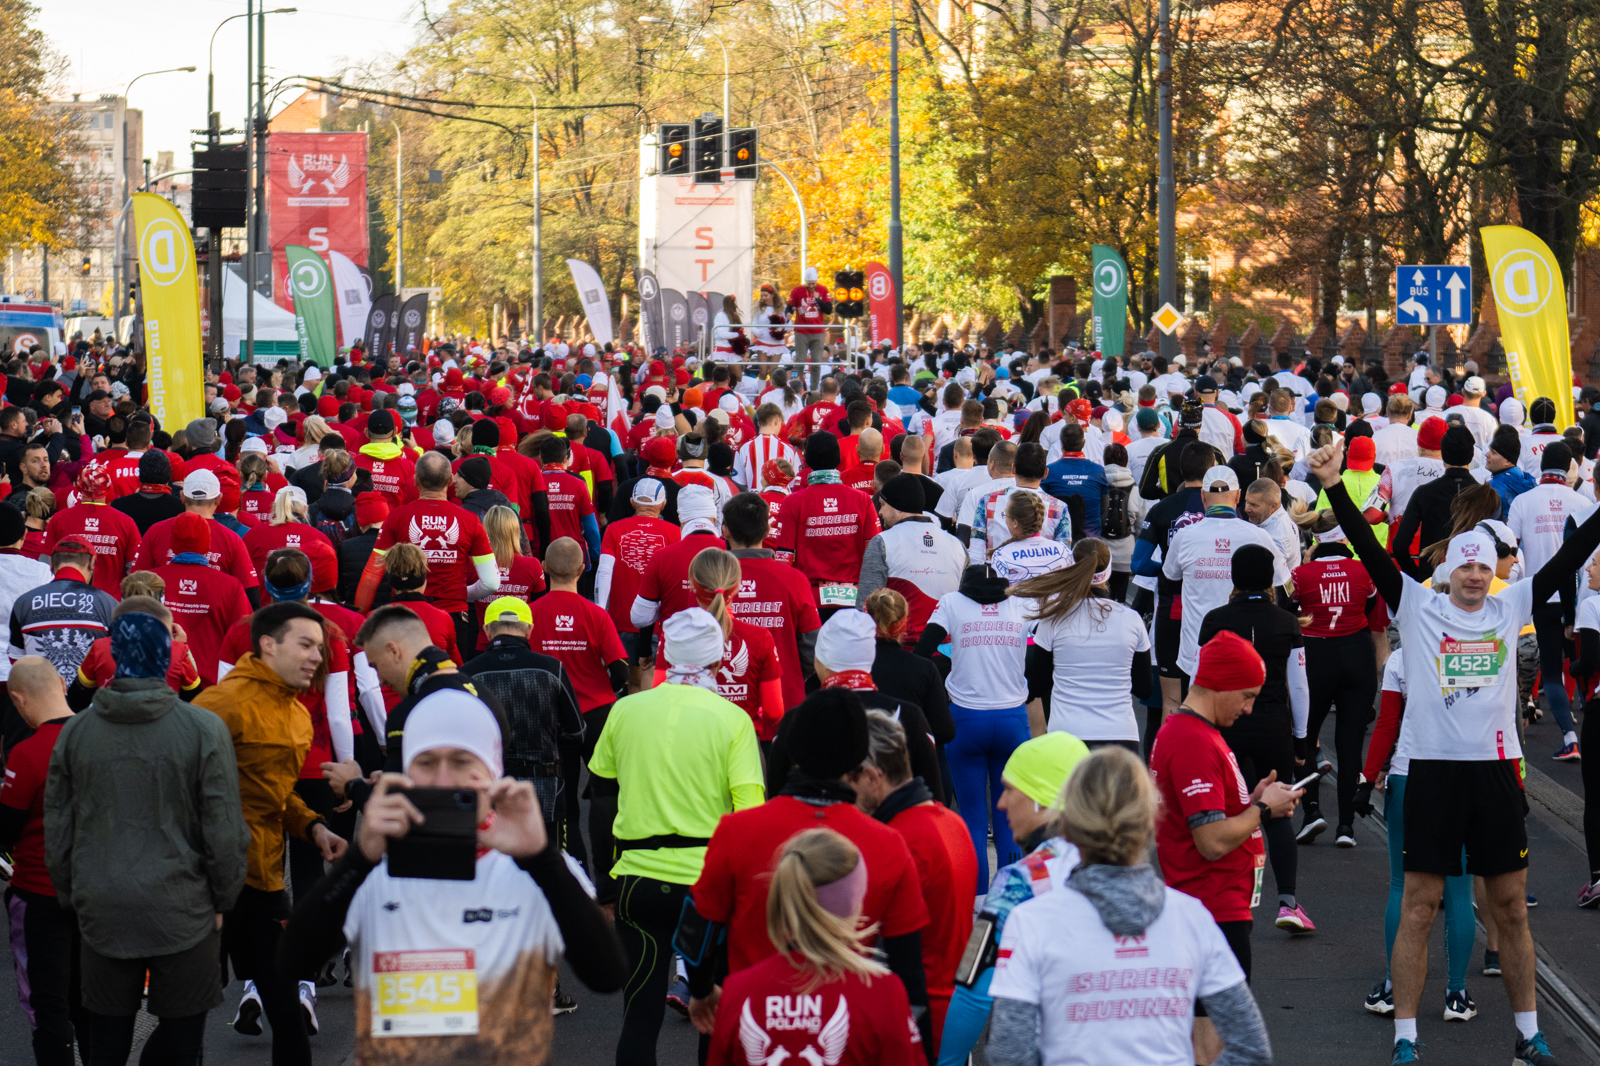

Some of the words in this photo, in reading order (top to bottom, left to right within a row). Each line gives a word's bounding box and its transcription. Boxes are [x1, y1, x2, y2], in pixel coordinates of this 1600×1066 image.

[303, 154, 333, 165] RUN
[642, 278, 654, 296] A
[1409, 286, 1429, 296] BUS
[116, 467, 140, 478] POLS
[422, 515, 447, 525] RUN
[806, 514, 859, 526] STREET
[1535, 514, 1567, 523] STRE
[805, 525, 859, 537] RUNNER
[426, 550, 457, 559] EAM
[1012, 546, 1061, 561] PAULINA
[1196, 557, 1232, 567] STRE
[827, 587, 855, 598] 1124
[1319, 581, 1350, 604] WIKI
[32, 592, 77, 610] BIEG
[79, 593, 94, 603] 20
[78, 602, 93, 614] 22
[731, 602, 783, 614] TREET
[1328, 606, 1343, 630] 7
[962, 621, 1023, 634] STREET
[961, 635, 1022, 648] RUNNER
[1448, 655, 1491, 671] 4523
[1067, 966, 1193, 994] STREET
[384, 975, 462, 1008] 3545
[766, 994, 822, 1017] RUN
[1066, 996, 1191, 1022] RUNNER
[766, 1016, 822, 1031] POLAND
